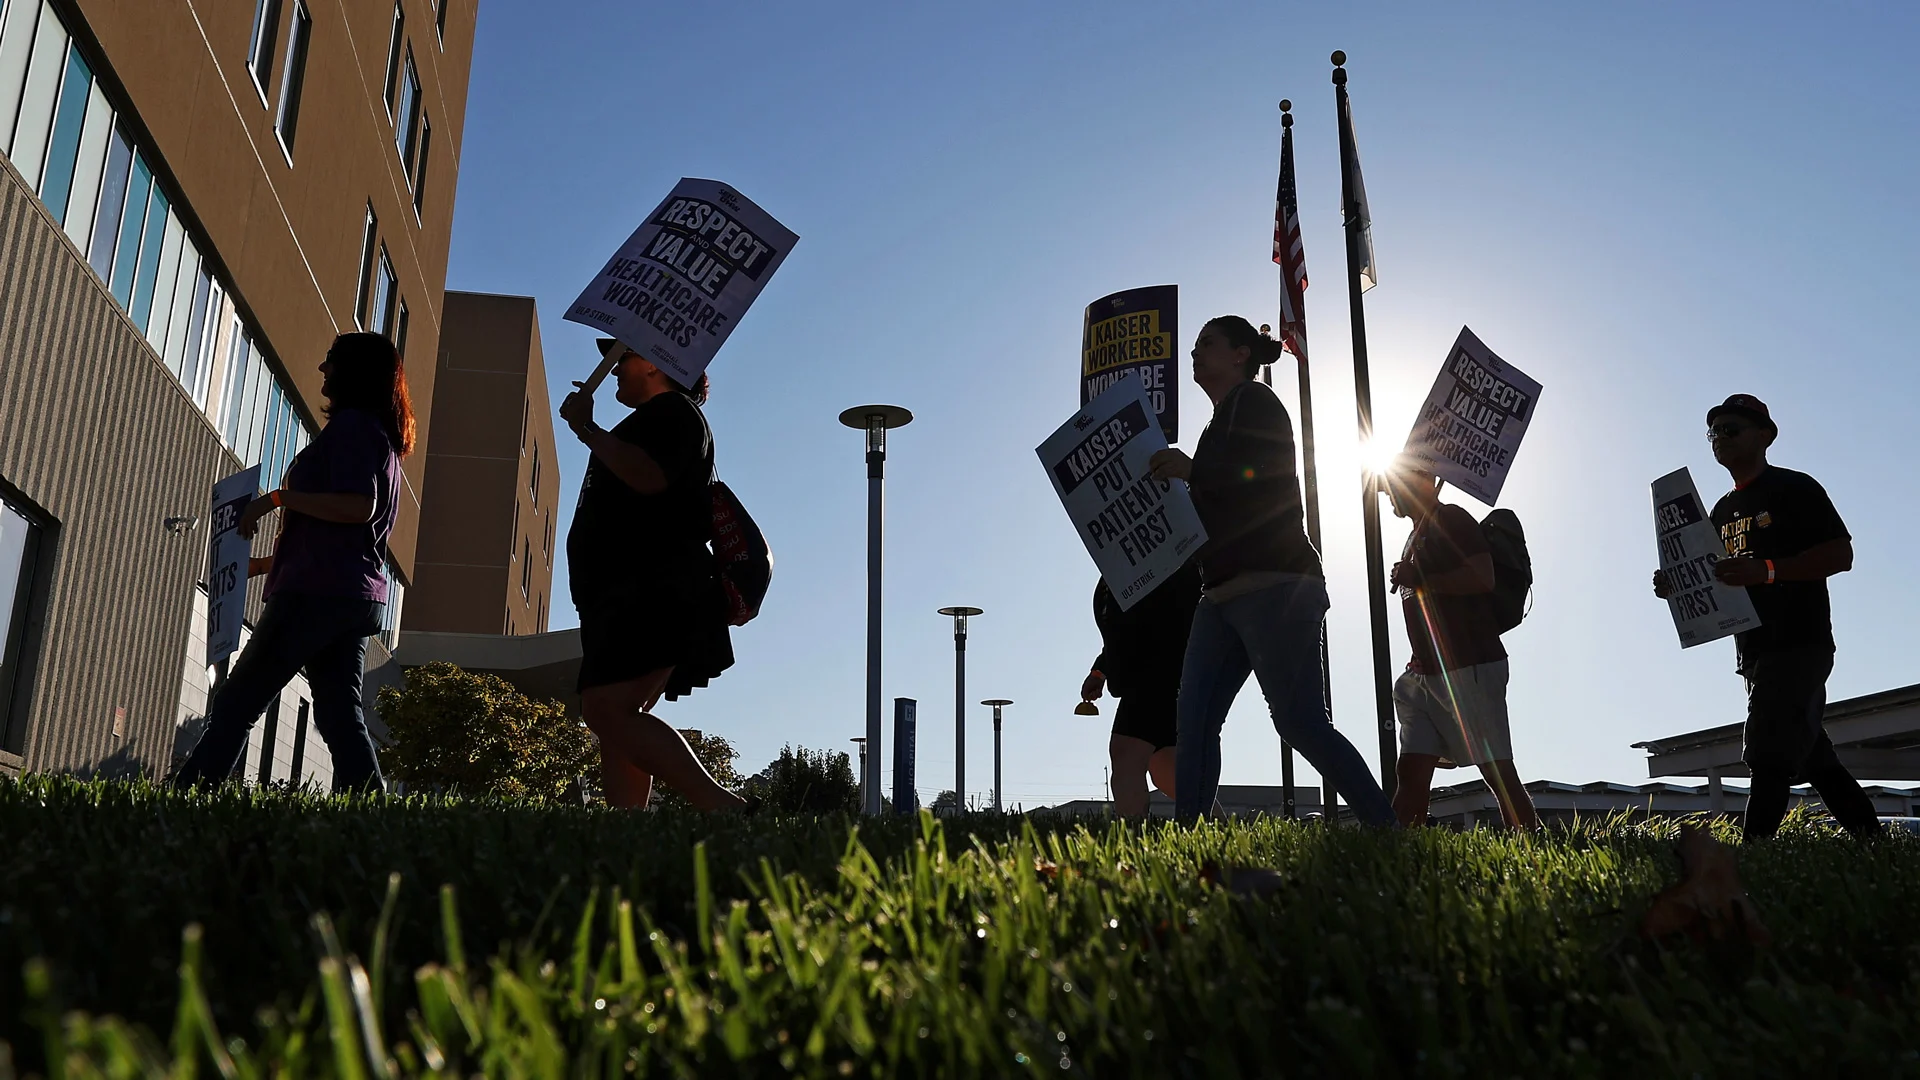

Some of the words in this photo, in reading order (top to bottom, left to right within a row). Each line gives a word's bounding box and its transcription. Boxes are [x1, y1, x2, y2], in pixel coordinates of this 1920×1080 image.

[660, 199, 768, 269] RESPECT
[689, 234, 710, 250] AND
[649, 232, 729, 295] VALUE
[575, 305, 591, 315] ULP
[589, 309, 618, 326] STRIKE
[601, 281, 697, 348] WORKERS
[606, 257, 728, 337] HEALTHCARE
[1087, 335, 1165, 372] WORKERS
[1095, 314, 1151, 347] KAISER
[1138, 364, 1165, 389] BE
[1453, 352, 1526, 414] RESPECT
[1473, 393, 1487, 404] AND
[1424, 402, 1509, 467] HEALTHCARE
[1449, 387, 1503, 436] VALUE
[1066, 417, 1132, 482] KAISER:
[1424, 426, 1491, 478] WORKERS
[1092, 452, 1133, 502] PUT
[1118, 505, 1173, 567] FIRST
[1661, 533, 1687, 564] PUT
[1721, 517, 1753, 540] PATIENT
[1121, 583, 1135, 600] ULP
[1133, 570, 1156, 592] STRIKE
[1675, 586, 1720, 622] FIRST
